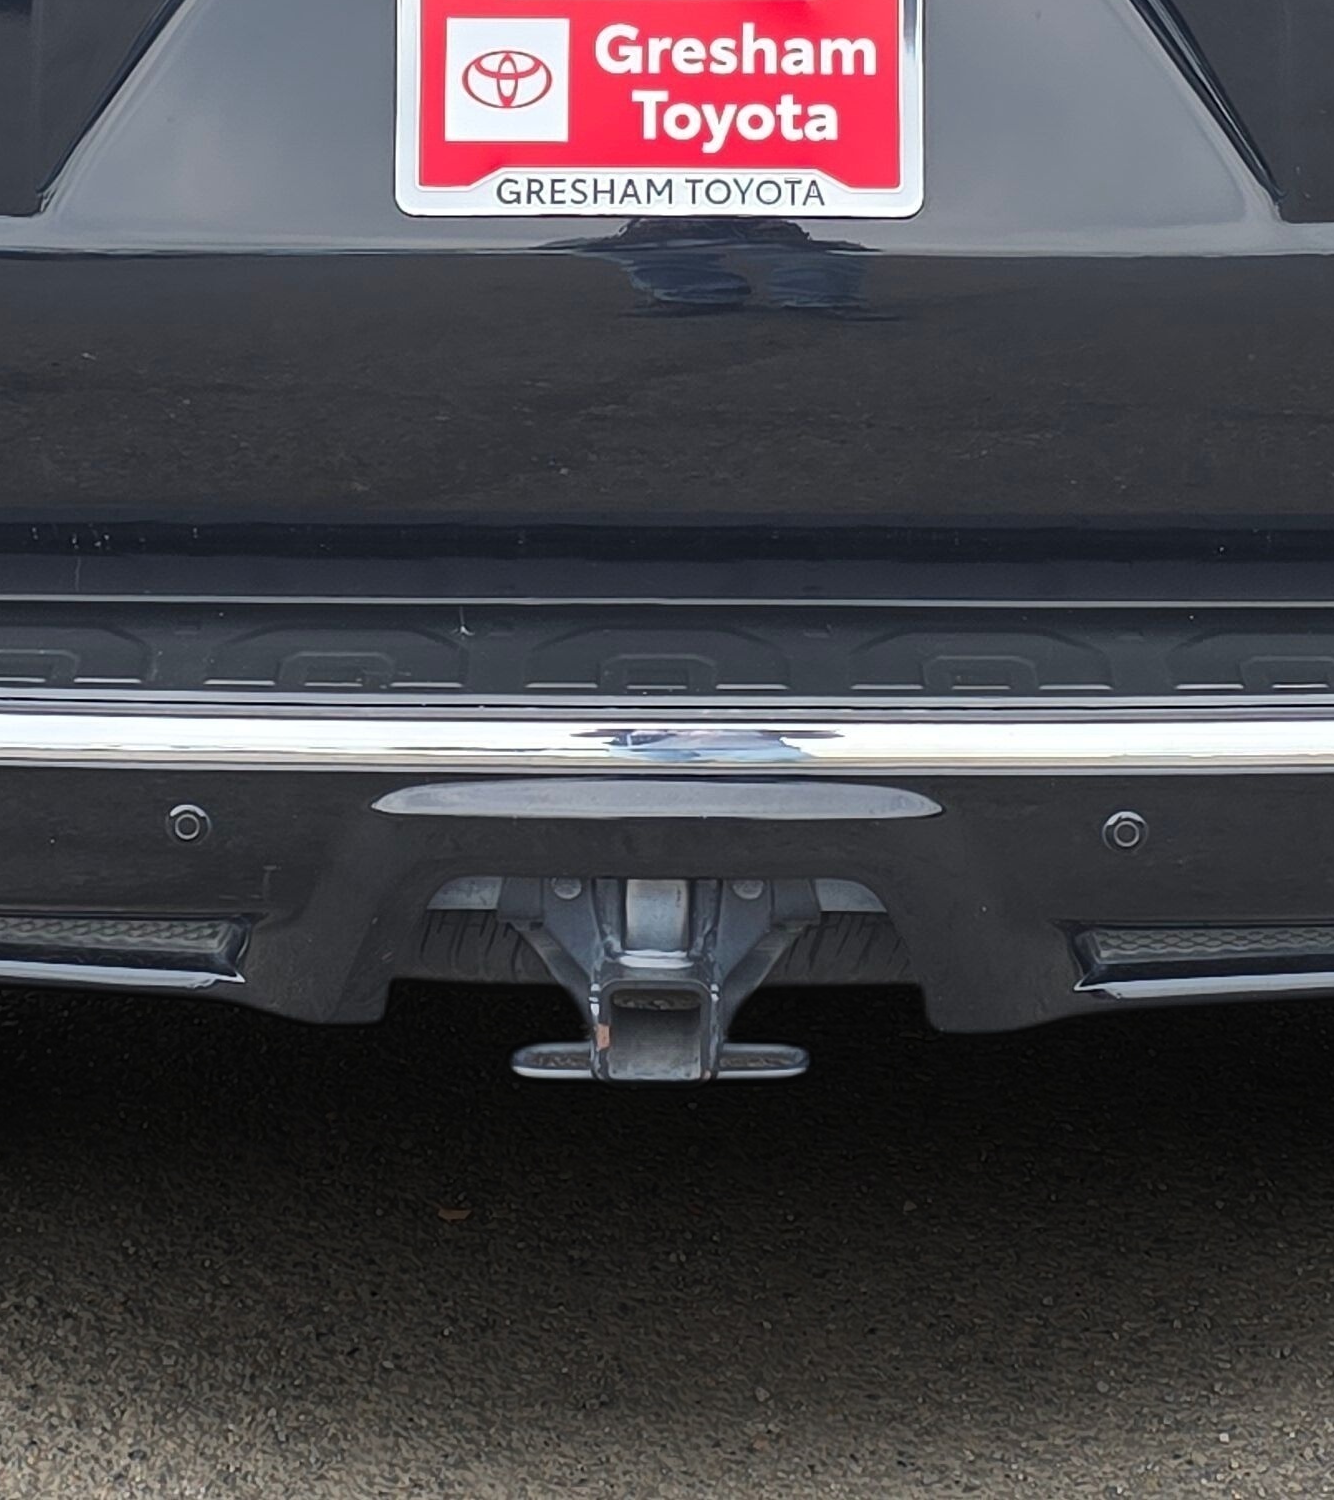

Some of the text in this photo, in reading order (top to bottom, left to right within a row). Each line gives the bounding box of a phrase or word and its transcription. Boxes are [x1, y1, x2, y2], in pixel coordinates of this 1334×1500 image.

[594, 22, 878, 77] Gresham
[631, 89, 839, 155] Toyota
[495, 177, 826, 207] GRESHAM TOYOTA
